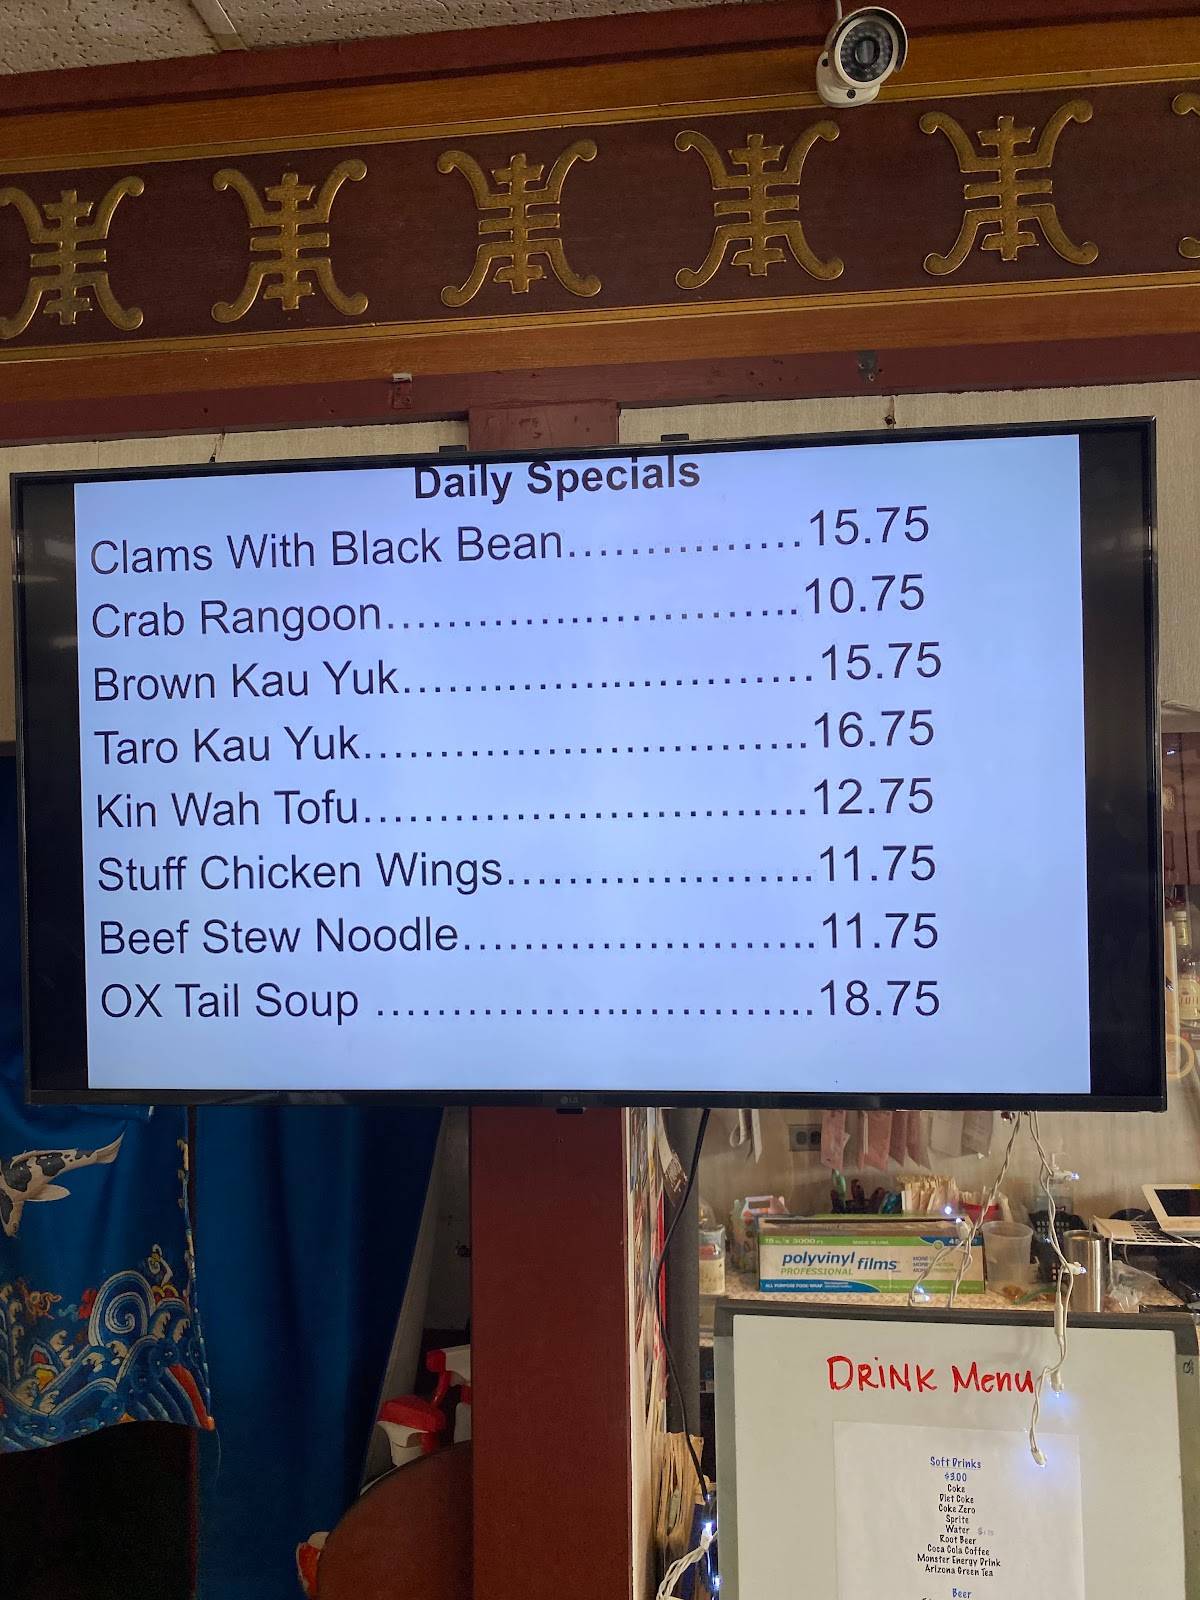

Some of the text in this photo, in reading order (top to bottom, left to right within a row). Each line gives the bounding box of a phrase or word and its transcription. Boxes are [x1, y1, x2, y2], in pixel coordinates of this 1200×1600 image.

[415, 456, 700, 505] Daily Specials
[91, 505, 929, 575] Clams With Black Bean 15.75
[92, 573, 925, 641] Crab Rangoon 10.75
[94, 641, 942, 702] Brown Kau Yuk 15.75
[94, 709, 934, 765] Taro Kau Yuk 16.75
[97, 777, 934, 828] Kin Wah Tofu 12.75
[98, 844, 936, 896] Stuff Chicken Wings 11.75
[101, 912, 938, 955] Beef Stew Noodle 11.75
[101, 979, 940, 1026] OX Tail Soup 18.75
[782, 1251, 897, 1270] polyvinyl films
[780, 1267, 853, 1276] PROFESSIONAL
[951, 1361, 1034, 1393] Menu
[930, 1456, 982, 1469] Soft Drinks
[944, 1472, 968, 1481] $3.00
[947, 1483, 966, 1493] Coke
[939, 1493, 974, 1503] Diet Coke
[938, 1503, 976, 1514] Coke Zero
[945, 1514, 969, 1525] Sprite
[945, 1524, 970, 1534] Water
[939, 1534, 977, 1545] Root Beer
[927, 1543, 990, 1556] Coca Cola Coffee
[917, 1553, 1001, 1567] Monster Energy Drink
[925, 1563, 994, 1577] Arizona Green Tea
[952, 1588, 972, 1599] Beer
